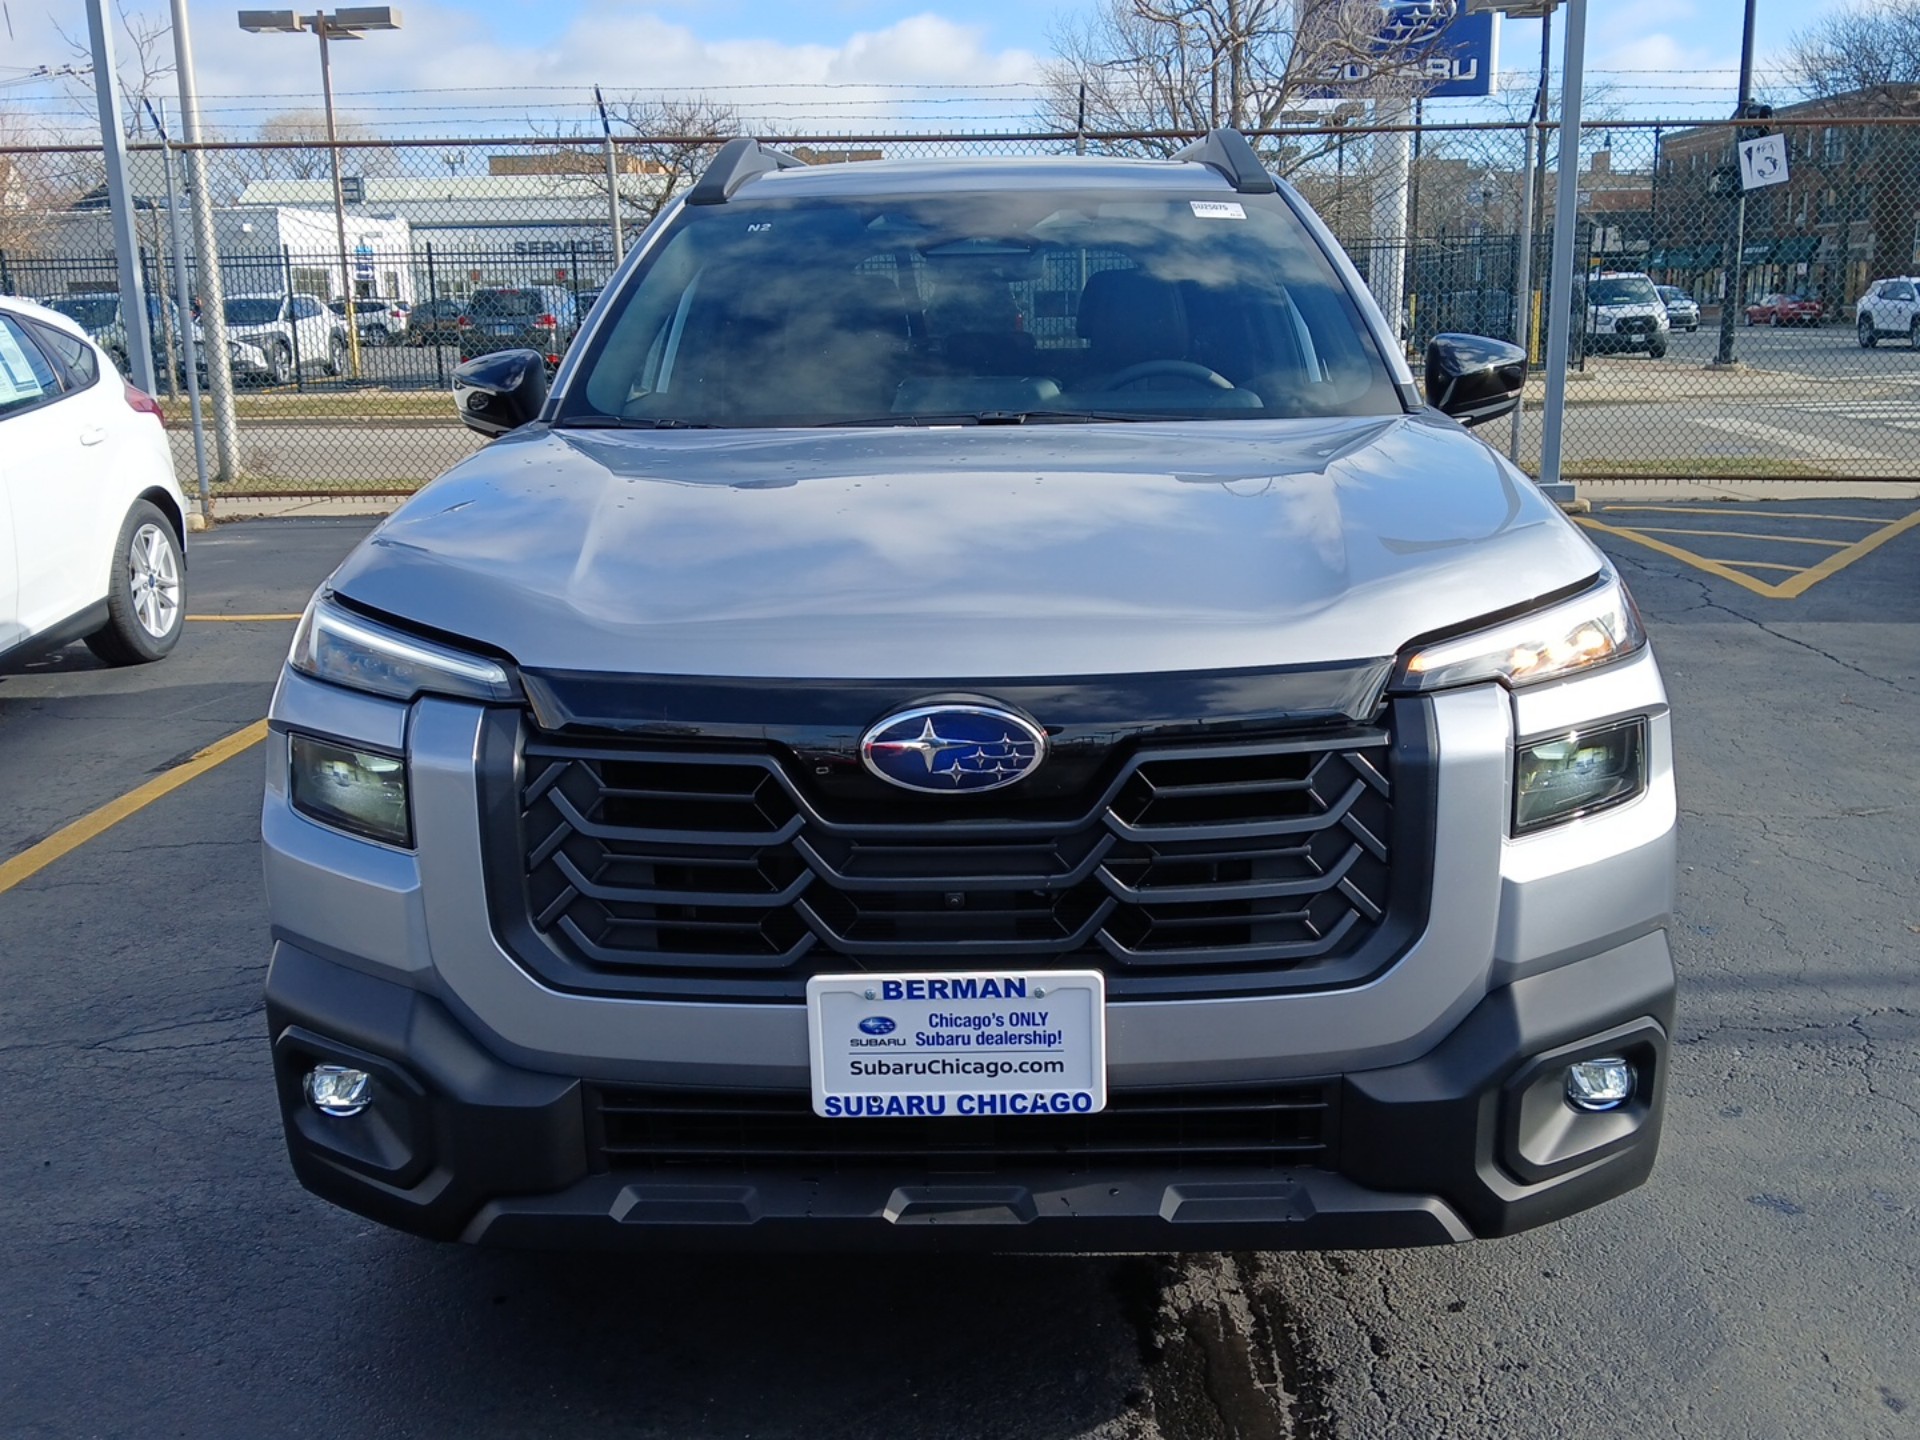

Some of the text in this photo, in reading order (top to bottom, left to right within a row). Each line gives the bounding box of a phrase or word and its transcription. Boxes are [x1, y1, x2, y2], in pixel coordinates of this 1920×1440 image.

[1744, 141, 1780, 180] 13
[747, 223, 772, 232] N2
[515, 240, 604, 254] SERVICE
[882, 977, 1027, 1001] BERMAN
[928, 1012, 1049, 1030] Chicago's ONLY
[850, 1038, 906, 1047] SUBARU
[915, 1030, 1062, 1047] Subaru dealership!
[850, 1059, 1064, 1078] SubaruChicago.com
[824, 1092, 1093, 1117] SUBARU CHICAGO
